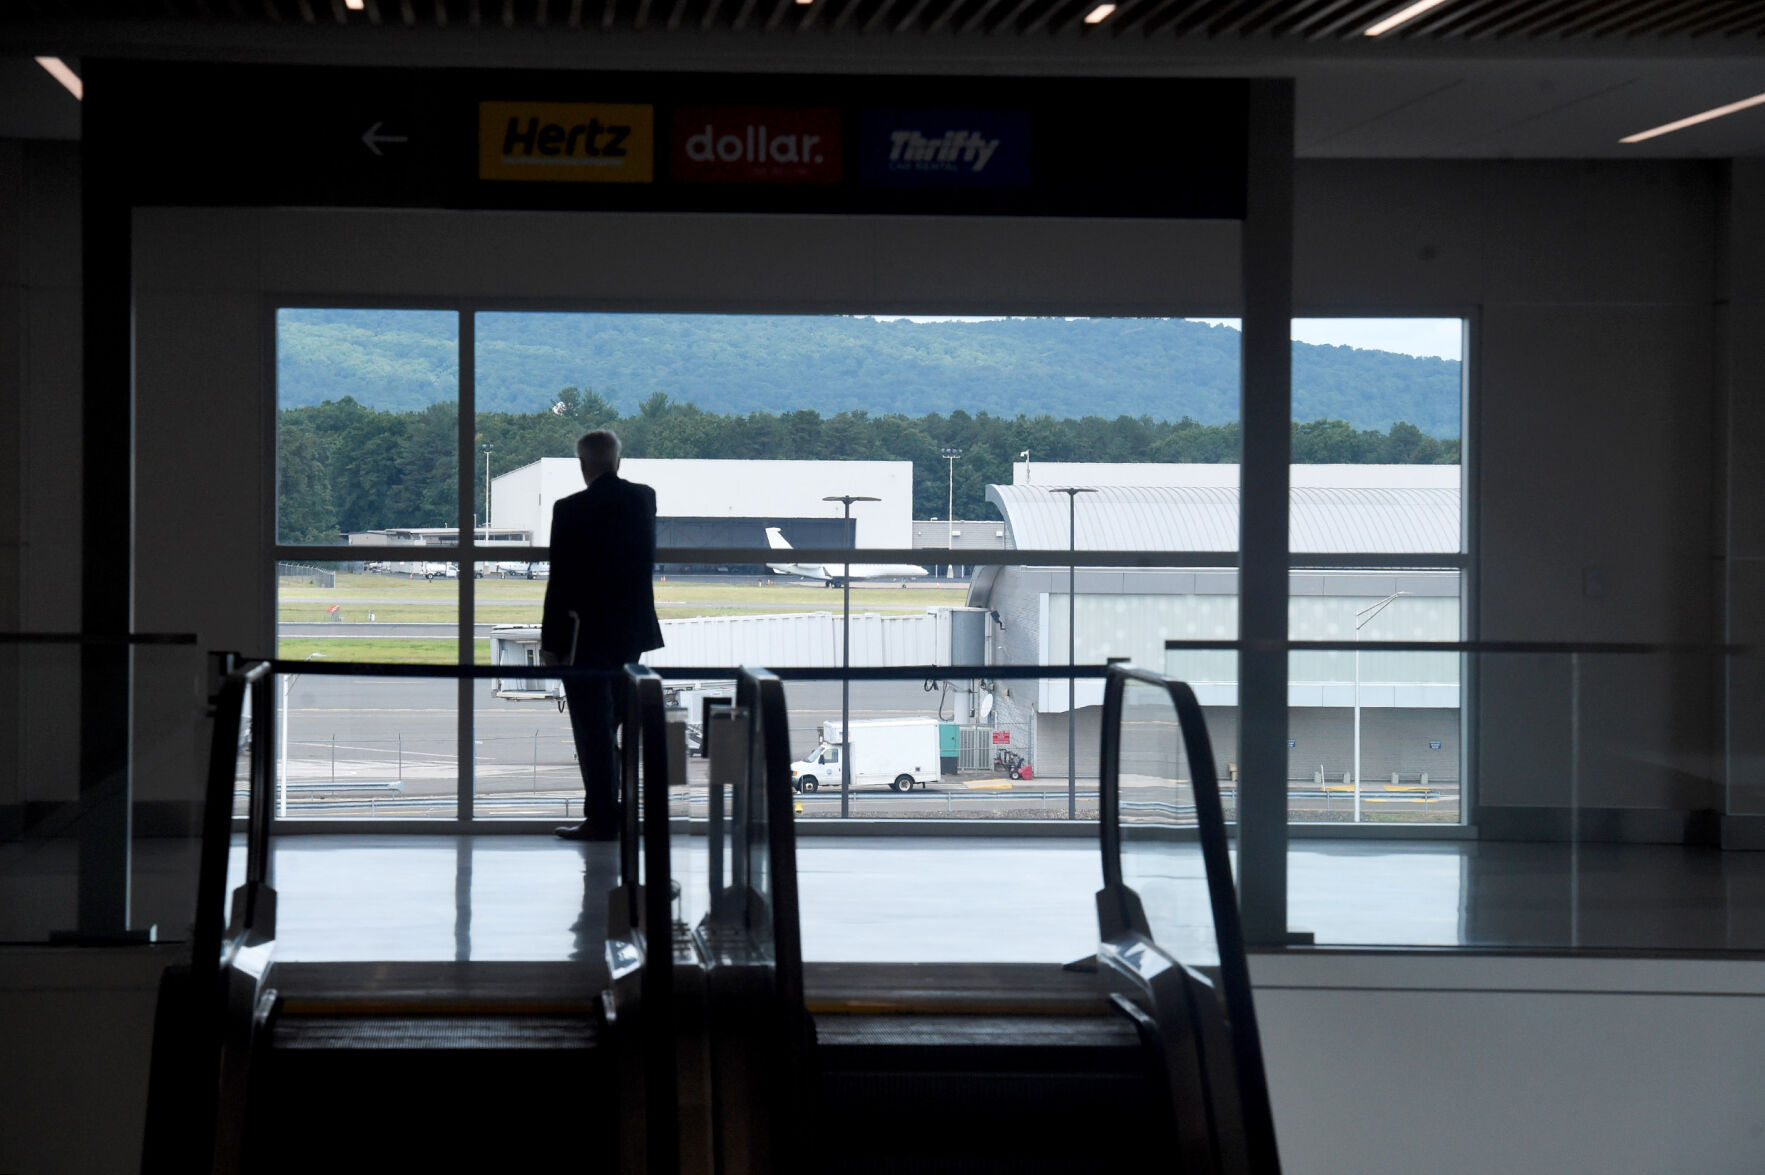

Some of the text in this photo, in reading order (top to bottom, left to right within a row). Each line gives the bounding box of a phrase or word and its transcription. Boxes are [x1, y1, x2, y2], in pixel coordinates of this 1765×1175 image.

[503, 117, 631, 156] Hertz
[684, 123, 824, 165] dollar.
[888, 128, 1001, 174] Thrifty
